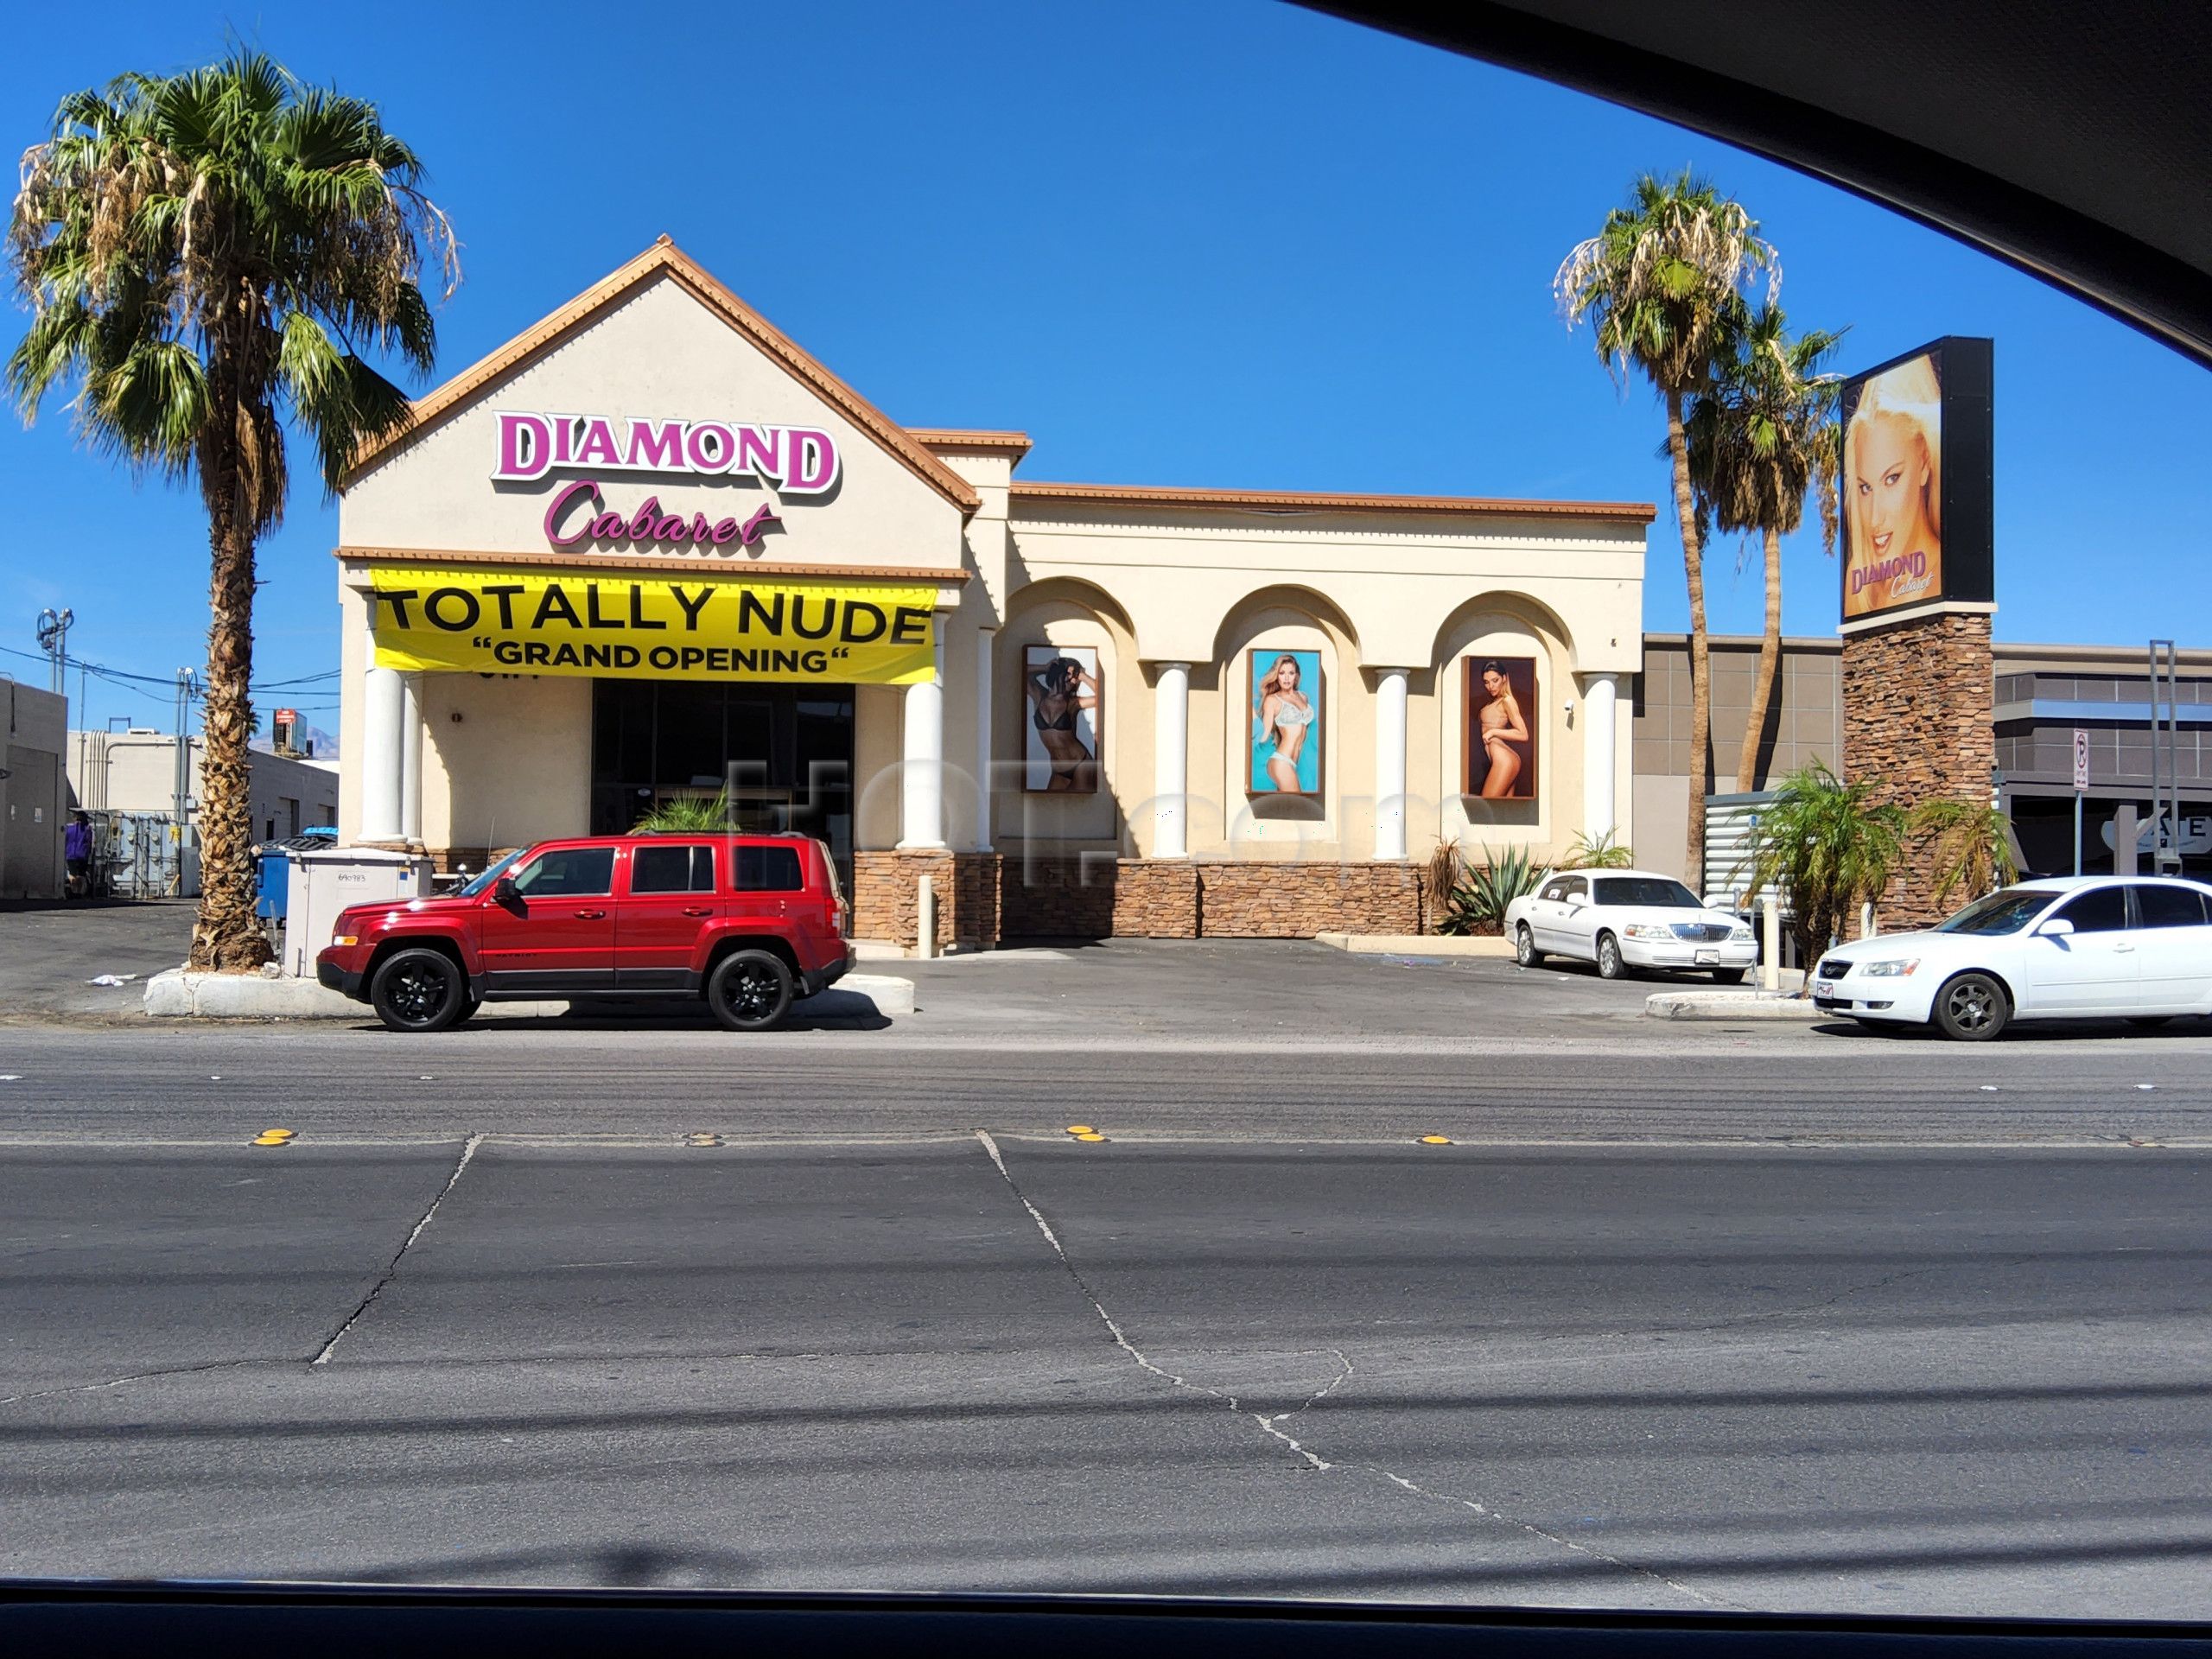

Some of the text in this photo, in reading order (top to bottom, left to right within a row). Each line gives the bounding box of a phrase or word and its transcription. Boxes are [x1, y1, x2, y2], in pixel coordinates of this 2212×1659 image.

[490, 410, 840, 494] DIAMOND
[543, 480, 782, 545] Cabaret
[1852, 550, 1926, 594] DIAMOND
[377, 583, 931, 645] TOTALLY NUDE
[473, 636, 641, 669] “GRAND
